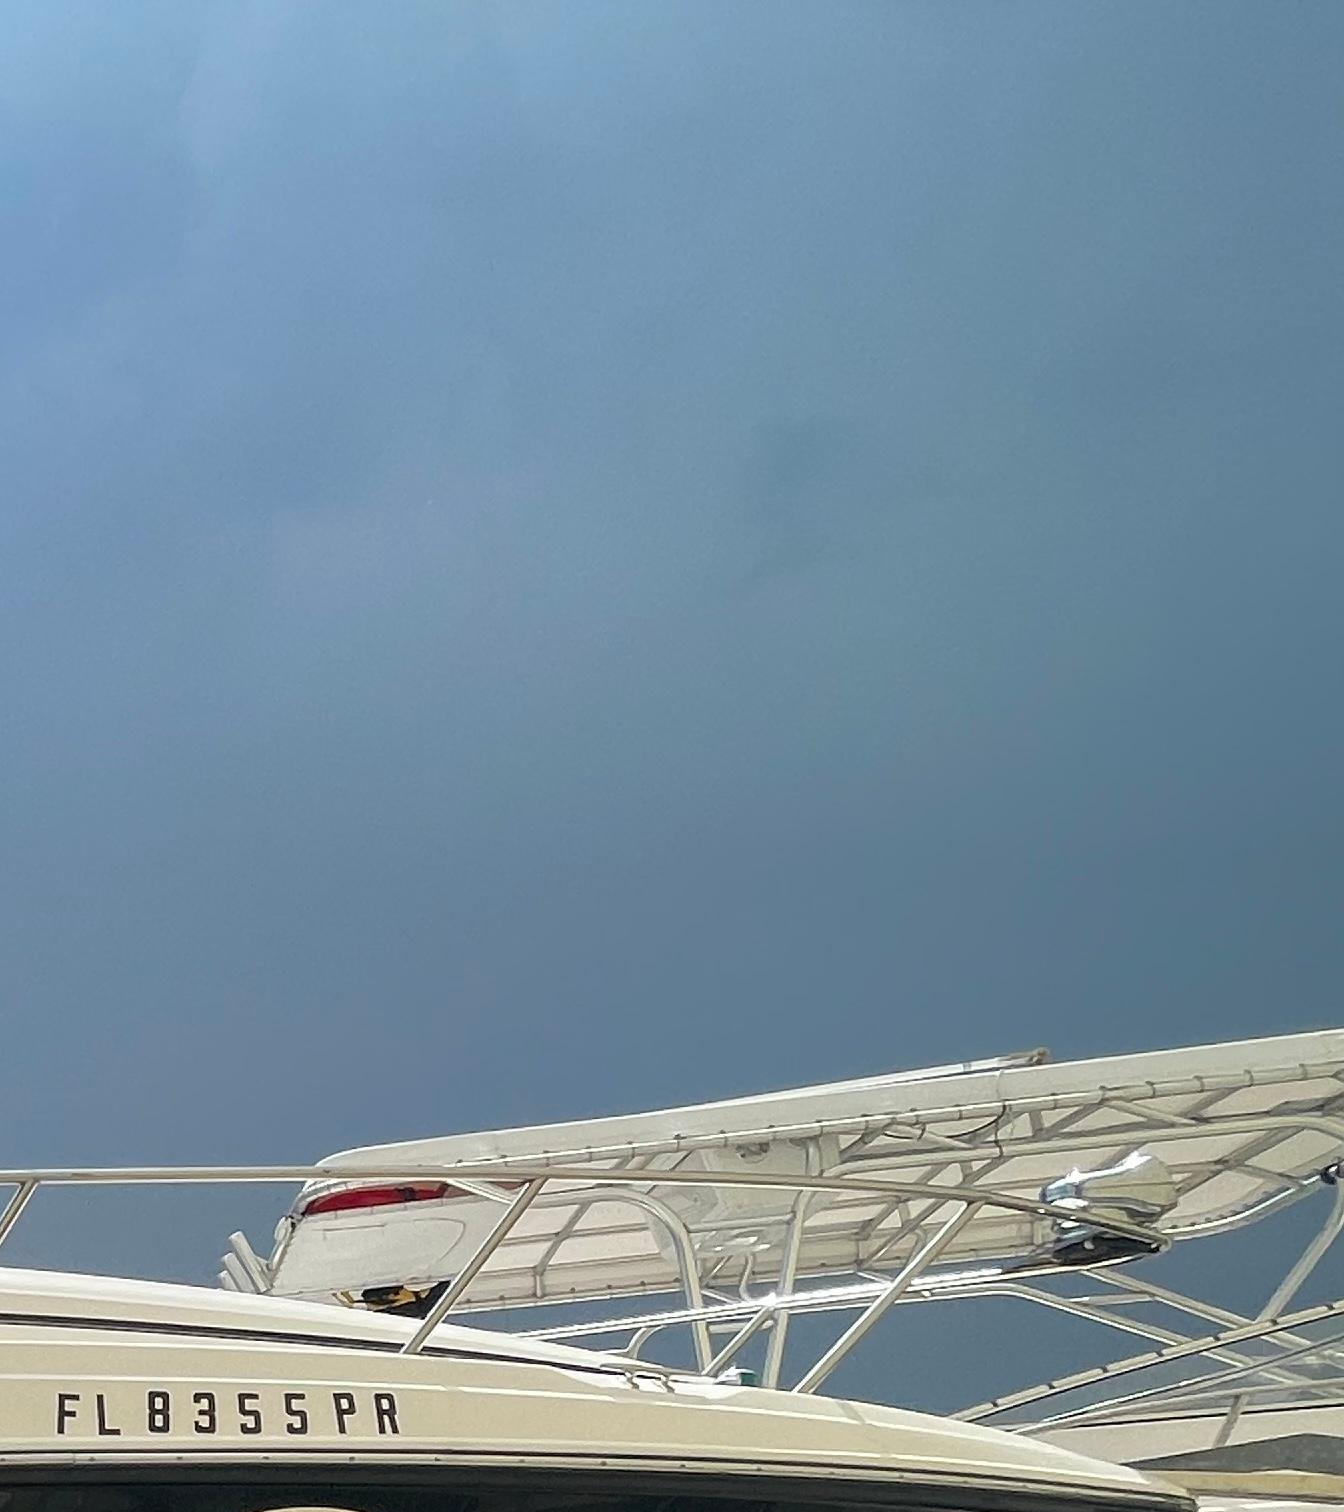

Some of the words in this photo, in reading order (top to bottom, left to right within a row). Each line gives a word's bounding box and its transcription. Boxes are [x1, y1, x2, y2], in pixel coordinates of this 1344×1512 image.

[56, 1392, 122, 1436] FL
[147, 1390, 309, 1435] 8355
[332, 1392, 400, 1435] PR
